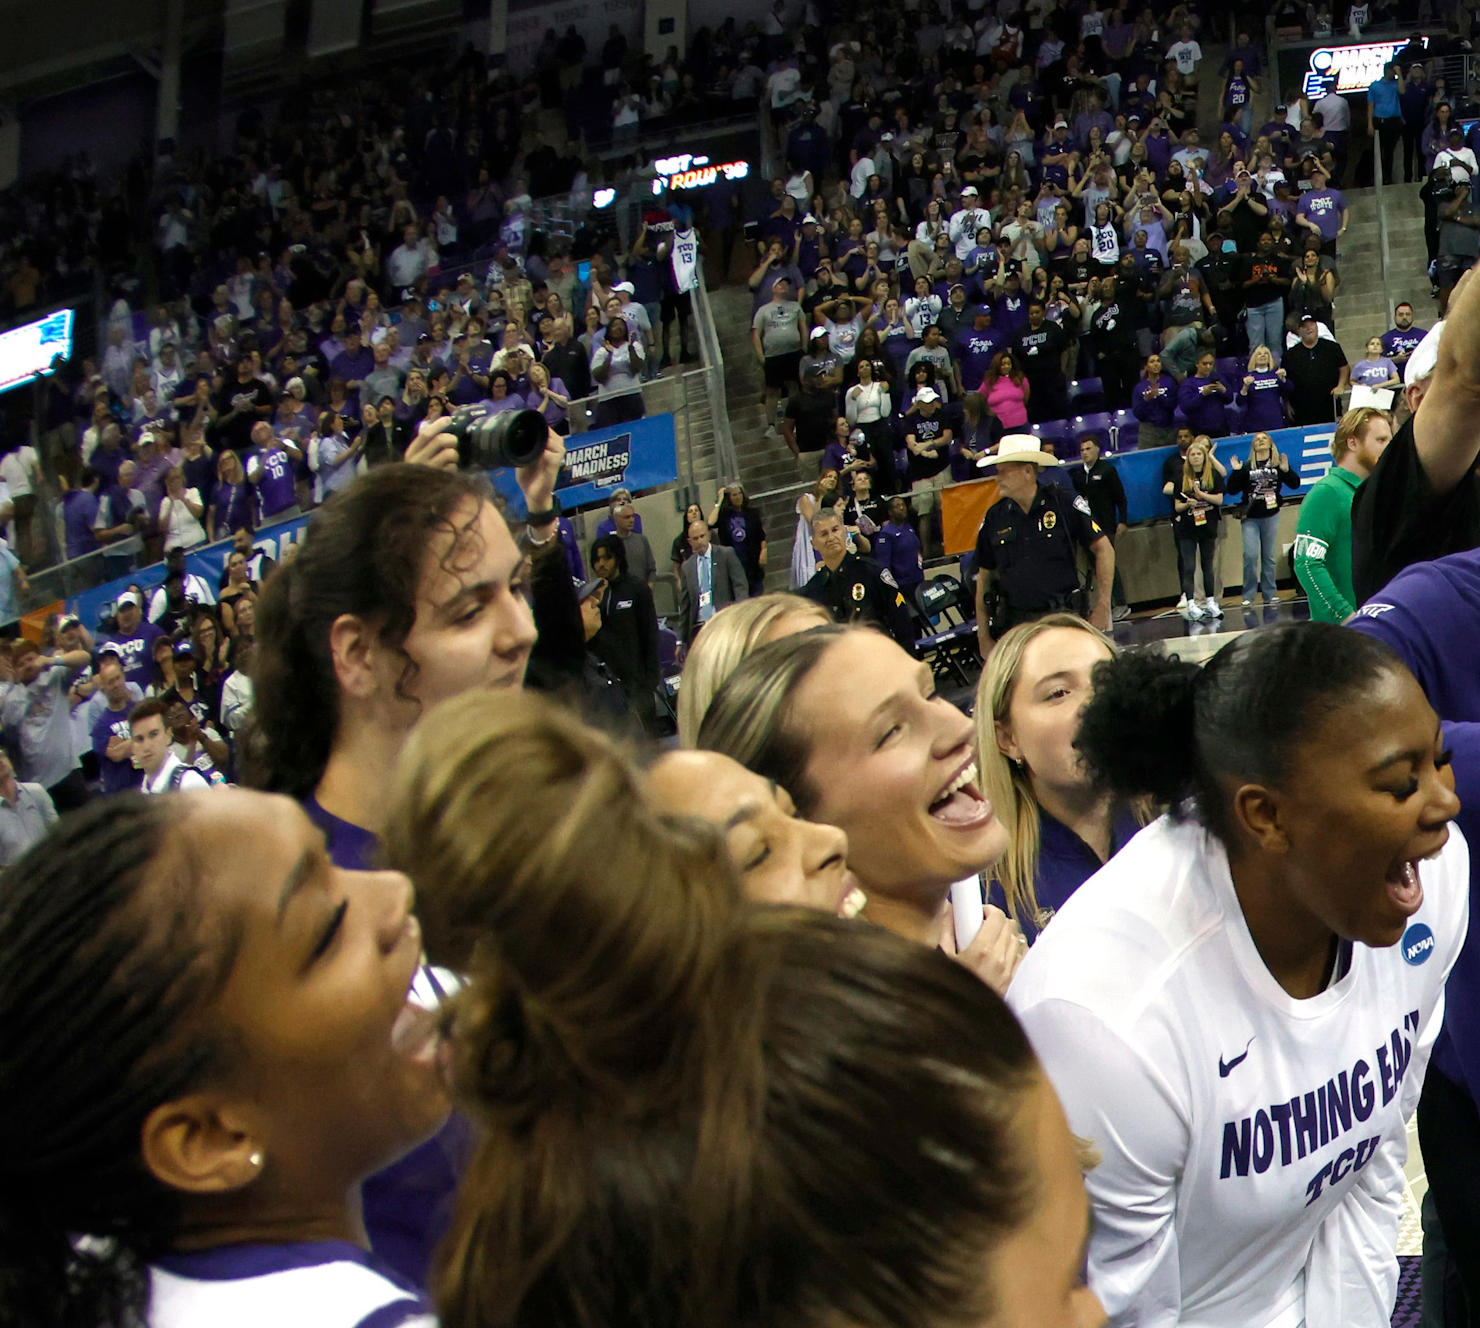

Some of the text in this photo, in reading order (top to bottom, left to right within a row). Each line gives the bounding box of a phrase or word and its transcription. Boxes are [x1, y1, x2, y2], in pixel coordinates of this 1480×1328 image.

[1021, 332, 1048, 347] TCU
[565, 442, 608, 469] MARCH
[571, 452, 630, 480] MADNESS
[271, 464, 284, 480] 10
[1406, 935, 1435, 959] NCAA
[1219, 1056, 1377, 1180] NOTHING
[1304, 1134, 1382, 1209] TCU
